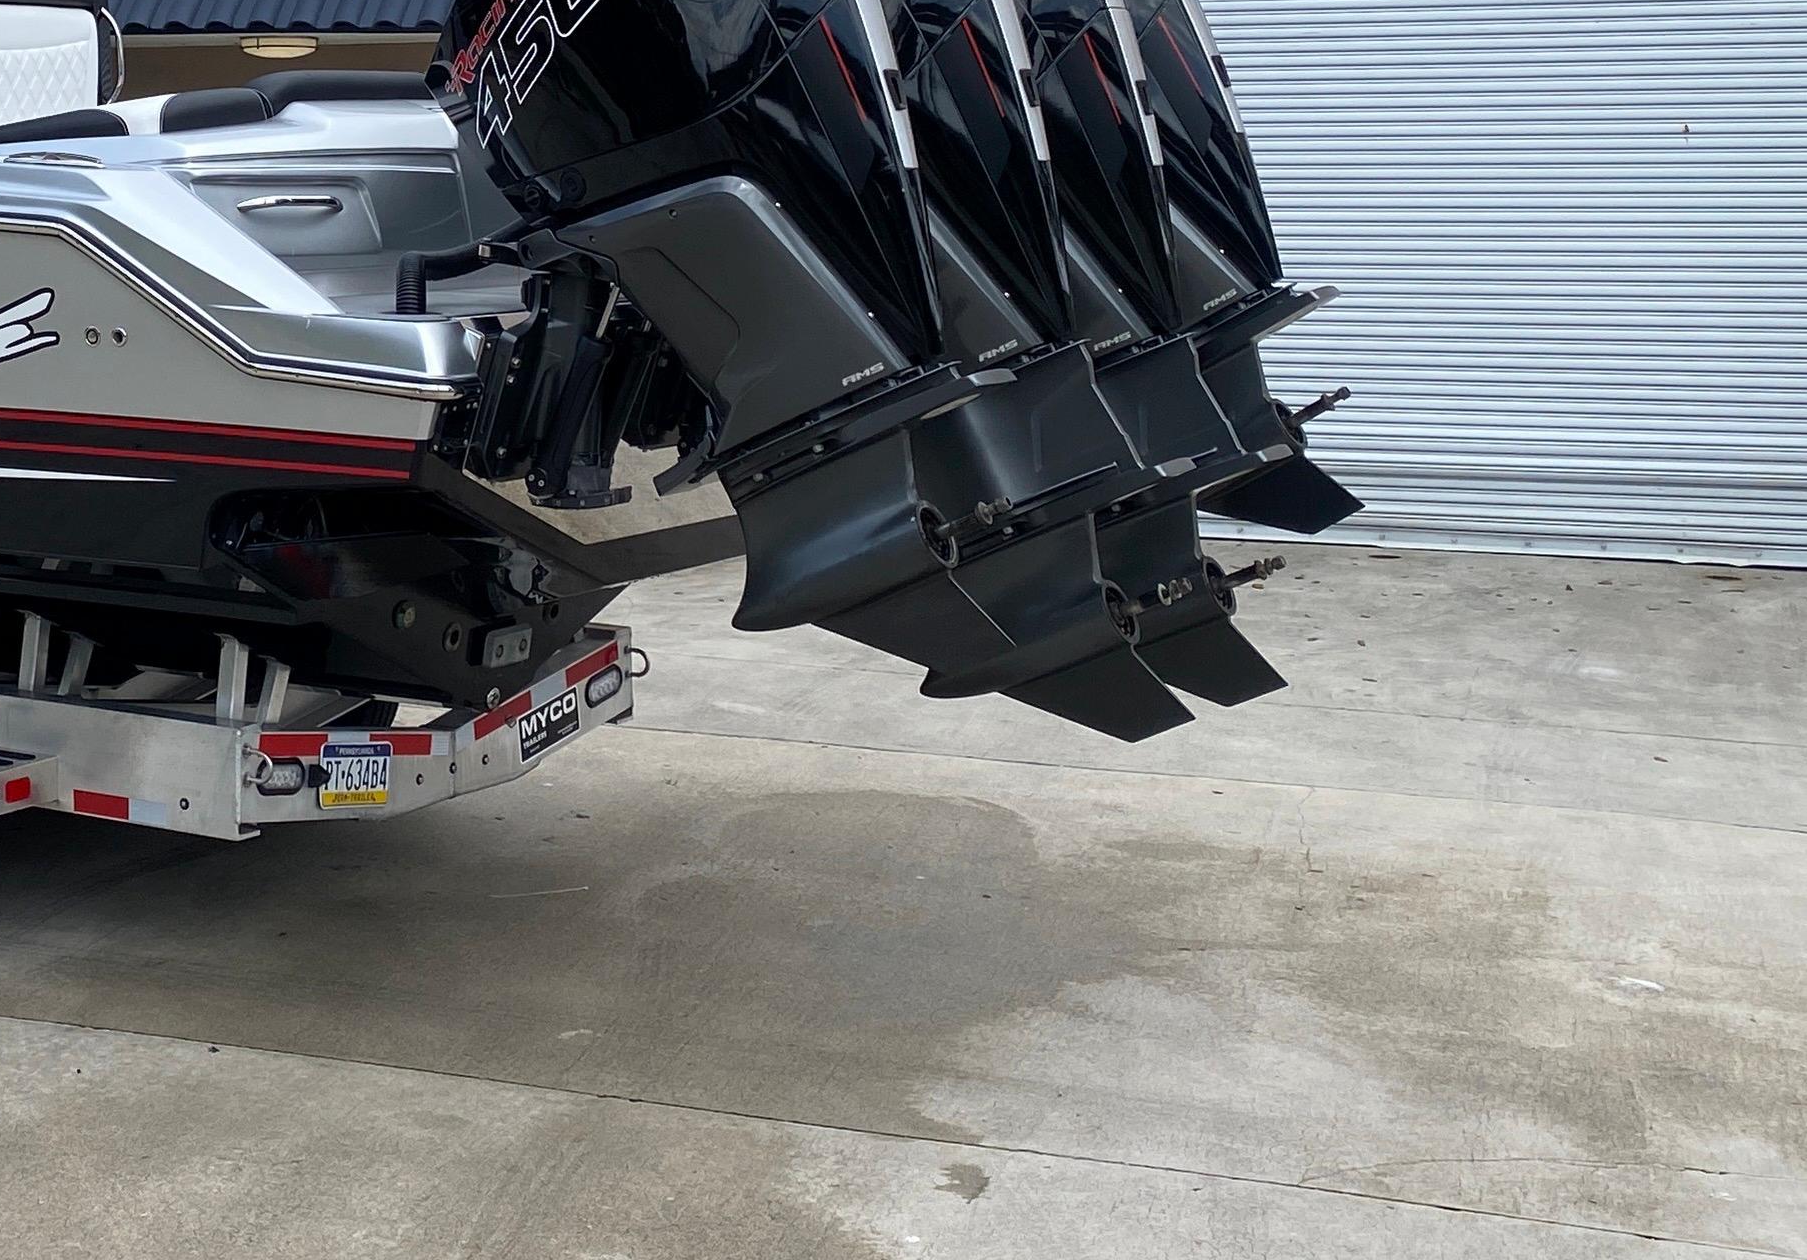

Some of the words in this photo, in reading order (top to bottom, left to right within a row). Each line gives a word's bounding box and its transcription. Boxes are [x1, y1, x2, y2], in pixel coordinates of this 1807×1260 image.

[978, 339, 1019, 363] AMS
[842, 362, 886, 387] AMS
[520, 692, 577, 740] MYCO
